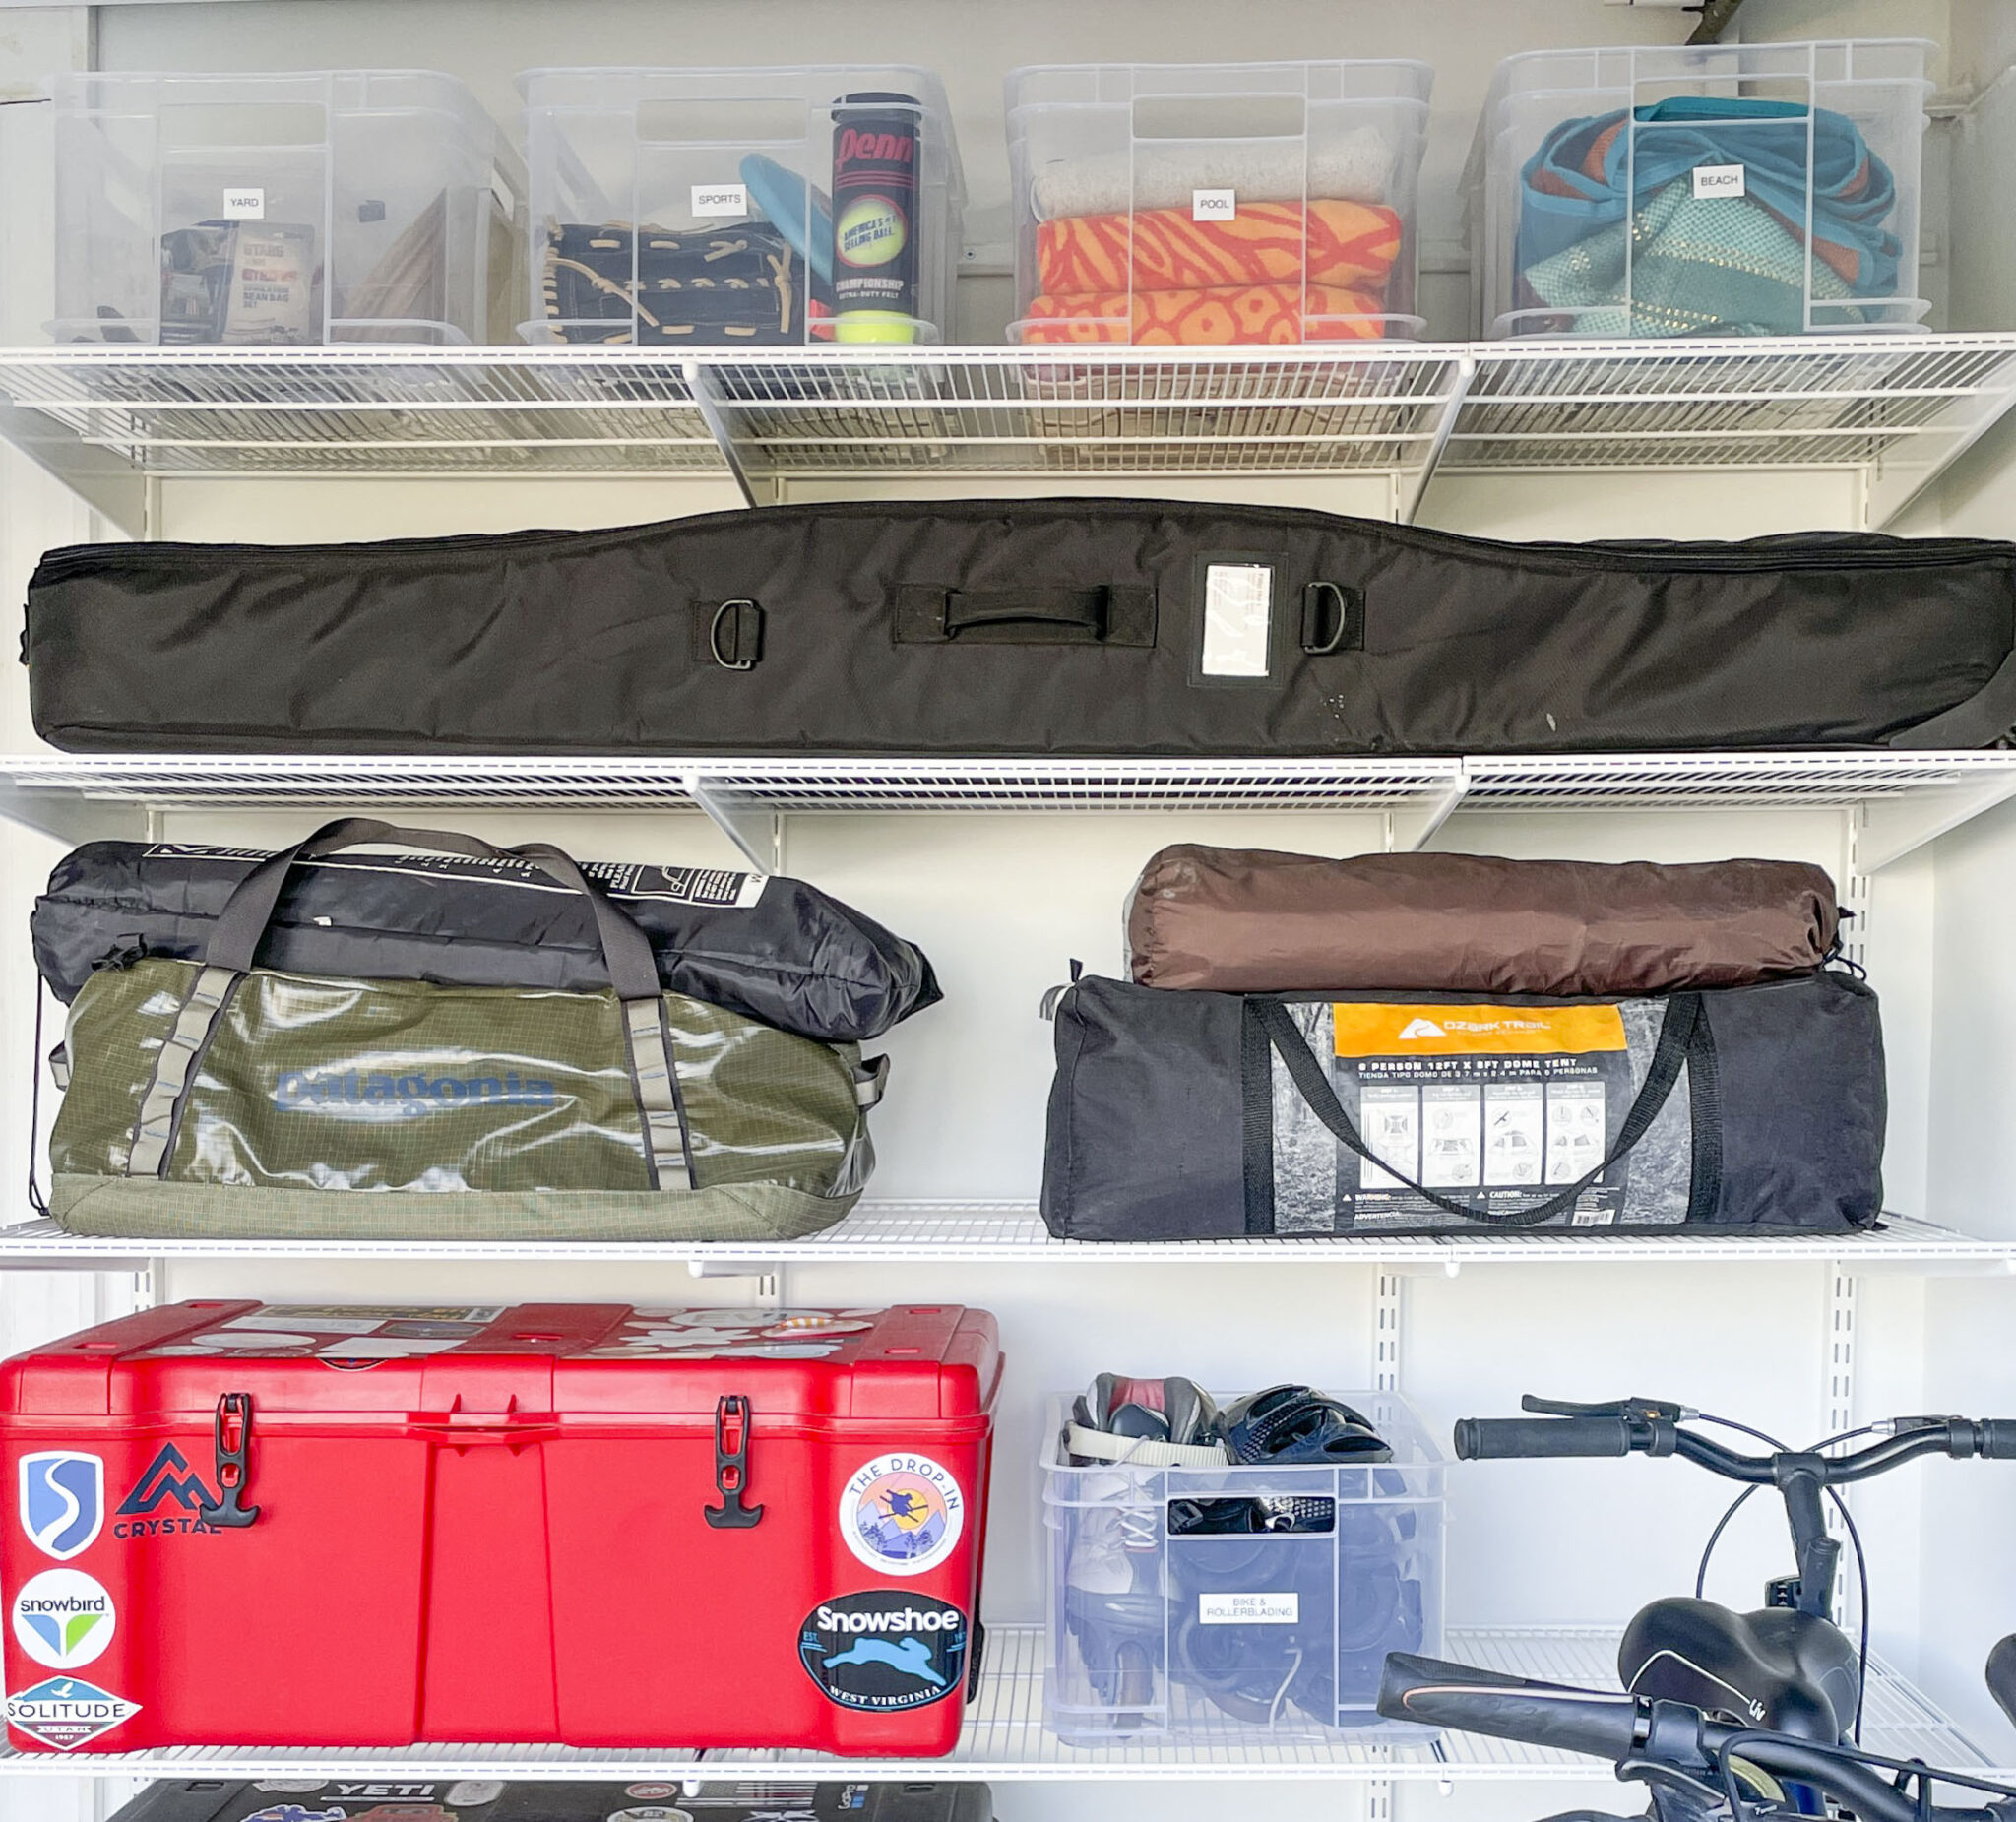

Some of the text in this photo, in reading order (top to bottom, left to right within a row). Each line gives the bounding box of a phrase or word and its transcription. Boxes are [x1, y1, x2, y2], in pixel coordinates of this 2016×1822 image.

[1701, 176, 1738, 186] BEACH
[230, 198, 259, 207] YARD
[698, 194, 741, 205] SPORTS
[1200, 199, 1229, 209] POOL
[844, 232, 872, 252] SELLING
[836, 278, 905, 292] CHAMPIONSHIP
[1371, 1062, 1422, 1071] PERSON
[1427, 1062, 1458, 1071] 12FT
[1504, 1060, 1540, 1069] DOME
[1544, 1058, 1577, 1068] TENT
[276, 1068, 555, 1116] patagonia
[849, 1458, 960, 1511] THE DROP-IN
[21, 1596, 105, 1612] snowbird
[1232, 1598, 1266, 1607] BIKE &
[1207, 1607, 1293, 1617] ROLLERBLADING
[817, 1606, 959, 1632] Snowshoe
[829, 1685, 941, 1705] WEST VIRGINIA
[8, 1703, 125, 1718] SOLITUDE
[337, 1784, 435, 1795] YETI
